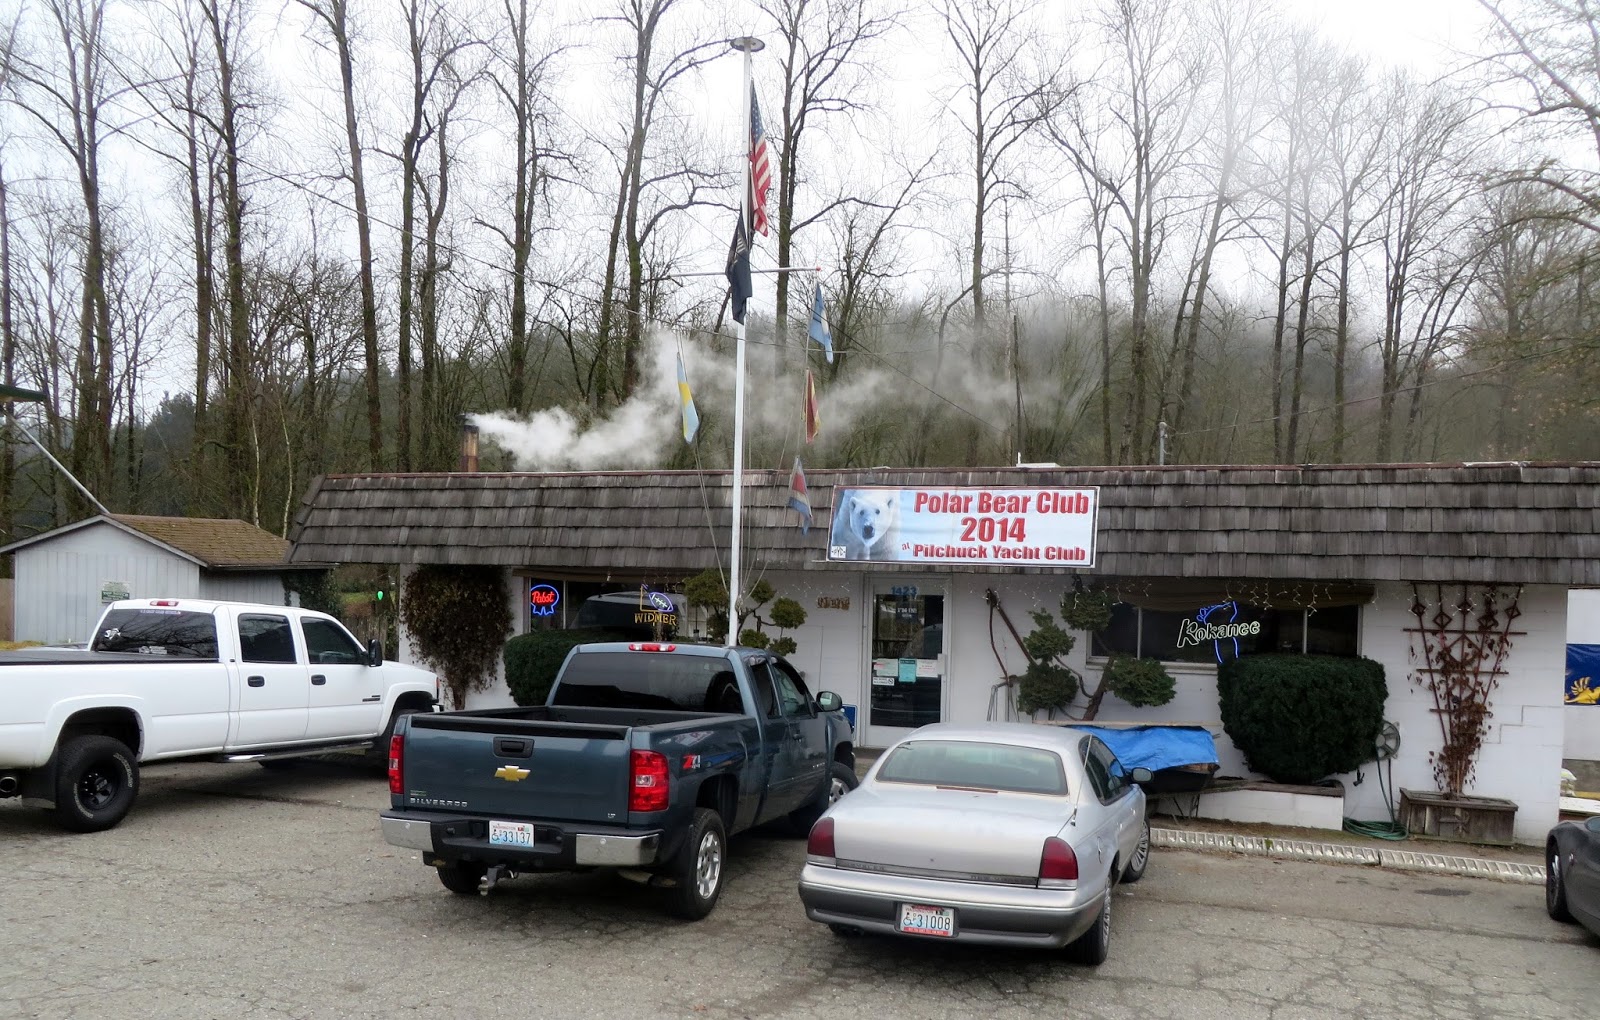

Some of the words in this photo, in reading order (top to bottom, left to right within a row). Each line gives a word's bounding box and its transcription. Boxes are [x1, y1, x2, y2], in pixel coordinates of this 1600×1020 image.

[914, 492, 971, 514] Polar
[977, 493, 1031, 514] Bear
[1036, 492, 1089, 514] Club
[960, 517, 1026, 543] 2014
[901, 542, 911, 551] at
[913, 543, 988, 559] Pilchuck
[993, 545, 1040, 560] Yacht
[1044, 546, 1086, 561] Club
[531, 591, 555, 604] Pabst
[634, 613, 677, 626] WIDMER
[1177, 618, 1261, 648] Kokanee
[410, 797, 468, 808] SILVERADO
[503, 830, 531, 845] 33137
[916, 914, 951, 930] 31008
